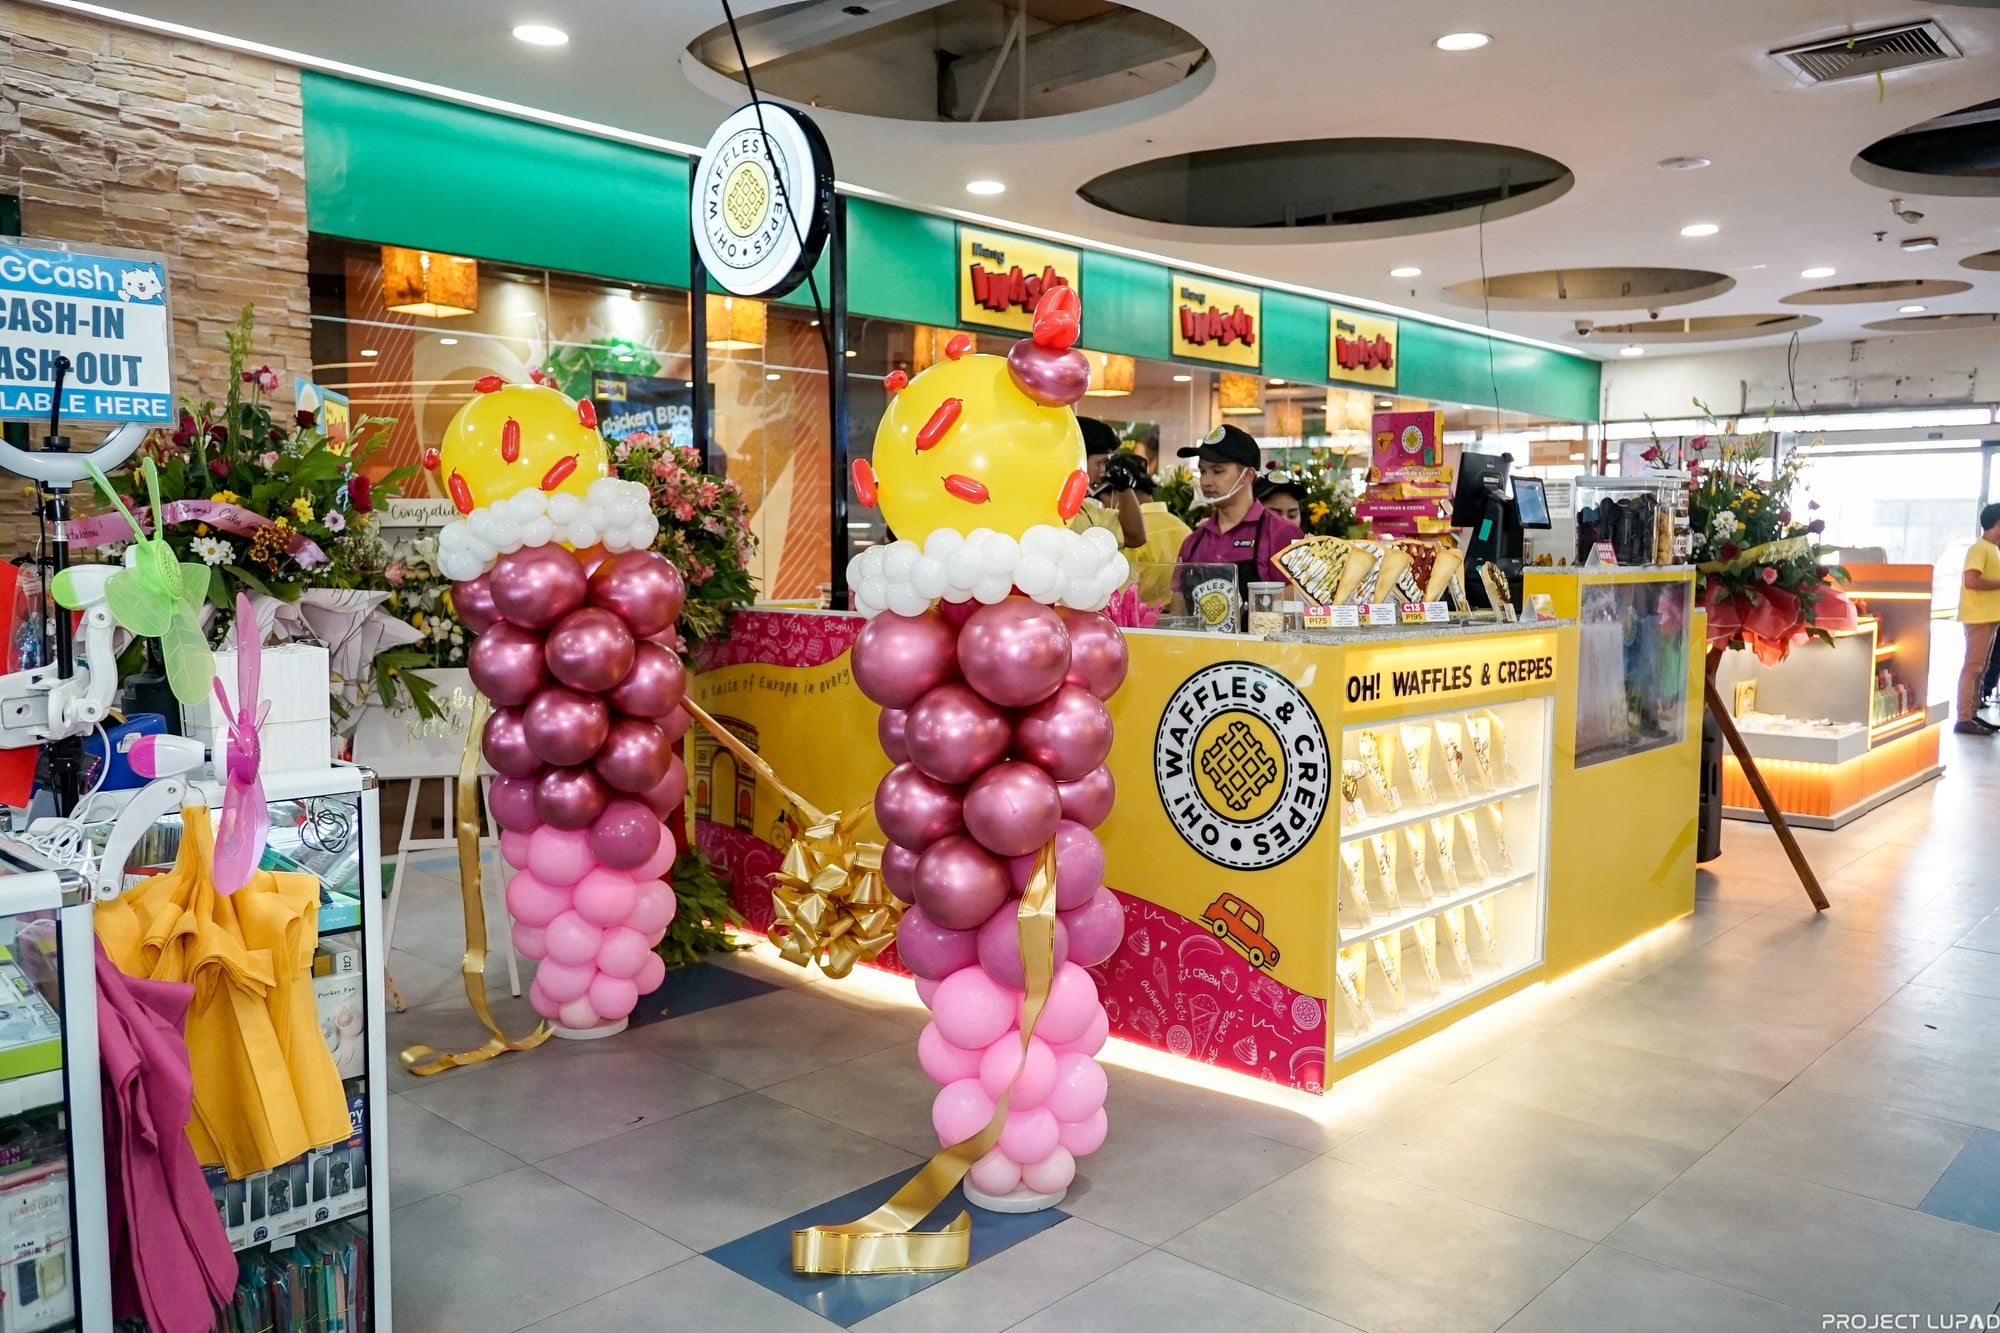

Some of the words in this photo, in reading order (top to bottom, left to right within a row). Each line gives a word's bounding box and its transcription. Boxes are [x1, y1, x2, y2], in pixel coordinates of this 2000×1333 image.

[709, 139, 759, 219] WAFFLES
[972, 242, 1005, 264] Mang
[1, 255, 115, 292] GCash
[0, 346, 143, 387] ASH-OUT
[95, 396, 168, 417] HERE
[391, 503, 459, 526] Congratul
[1309, 606, 1324, 616] C8
[1404, 602, 1420, 612] C13
[711, 680, 738, 697] taste
[743, 673, 755, 693] of
[759, 676, 798, 697] Europe
[804, 679, 815, 695] in
[820, 667, 850, 693] every
[1346, 672, 1381, 703] OH!
[1392, 664, 1472, 697] WAFFLES
[1480, 663, 1491, 686] &
[1498, 656, 1553, 684] CREPES
[1165, 676, 1268, 779] WAFFLES
[1275, 701, 1294, 724] &
[1253, 734, 1318, 855] CREPES
[1174, 792, 1219, 845] OH!
[317, 989, 340, 998] Pocket
[1140, 980, 1169, 1024] authentic
